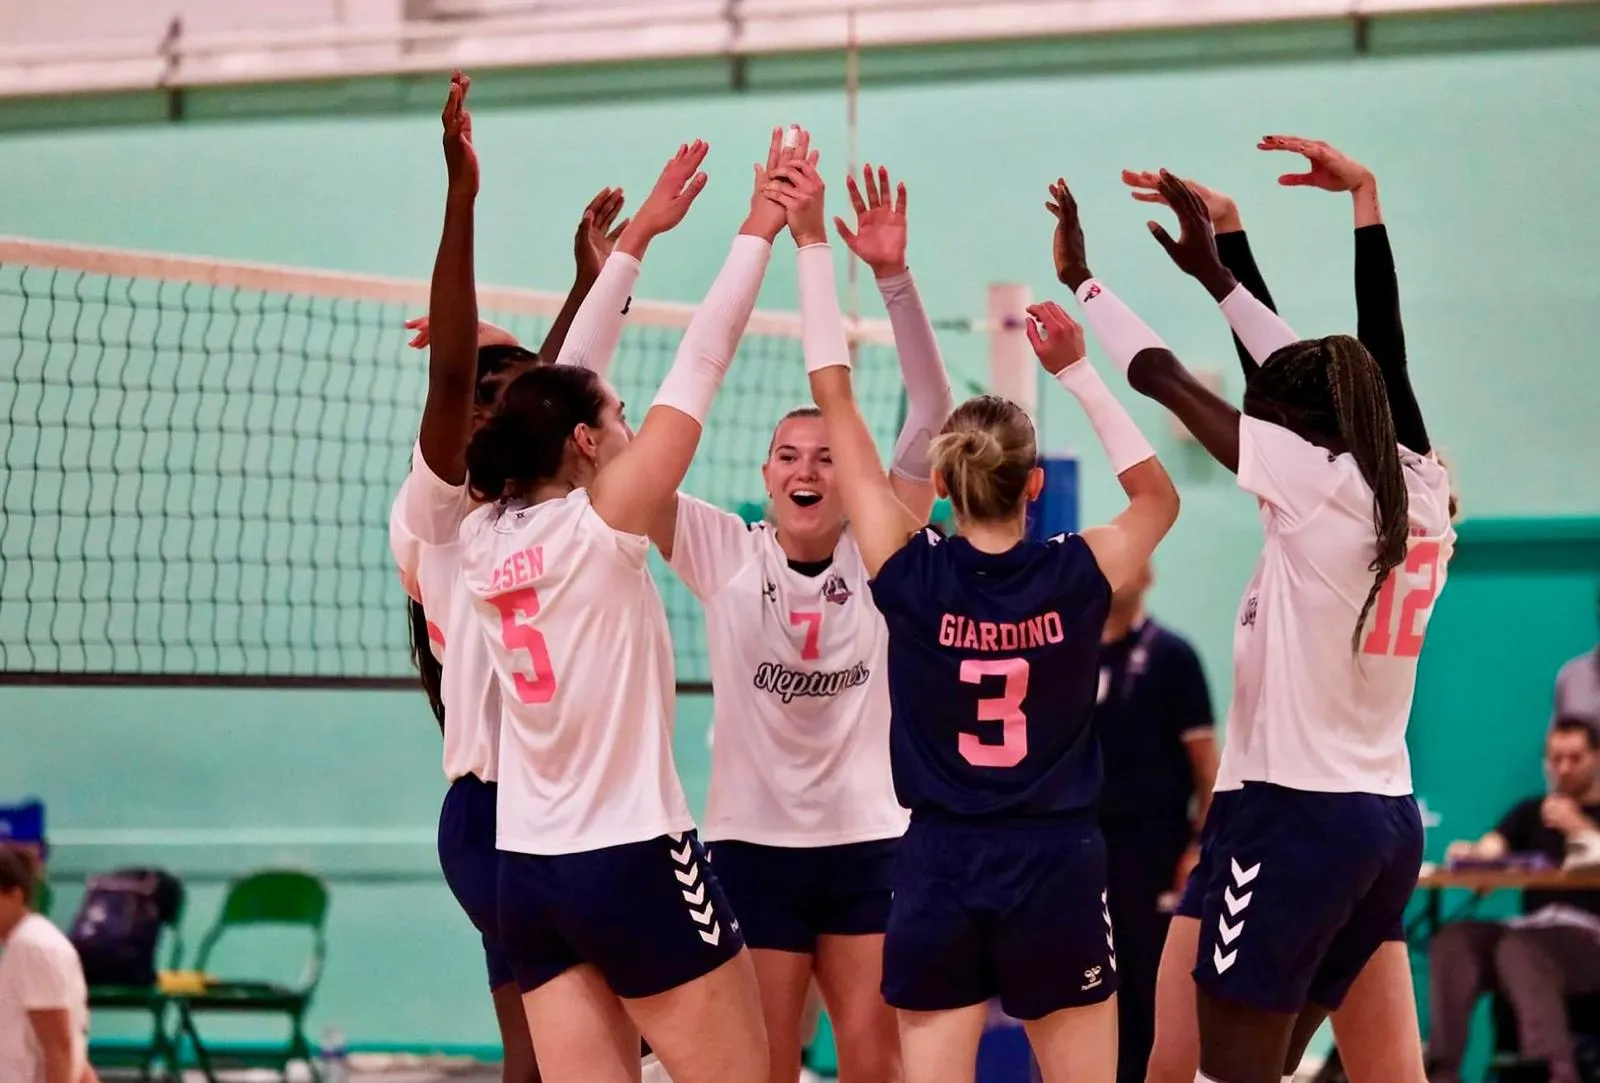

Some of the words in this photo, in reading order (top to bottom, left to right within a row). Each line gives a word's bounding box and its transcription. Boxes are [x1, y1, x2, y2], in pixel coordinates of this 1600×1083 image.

[790, 611, 823, 661] 7
[938, 611, 1065, 651] GIARDINO
[1363, 541, 1440, 657] 12
[483, 587, 557, 704] 5
[753, 660, 870, 704] Neptunes
[958, 657, 1030, 767] 3
